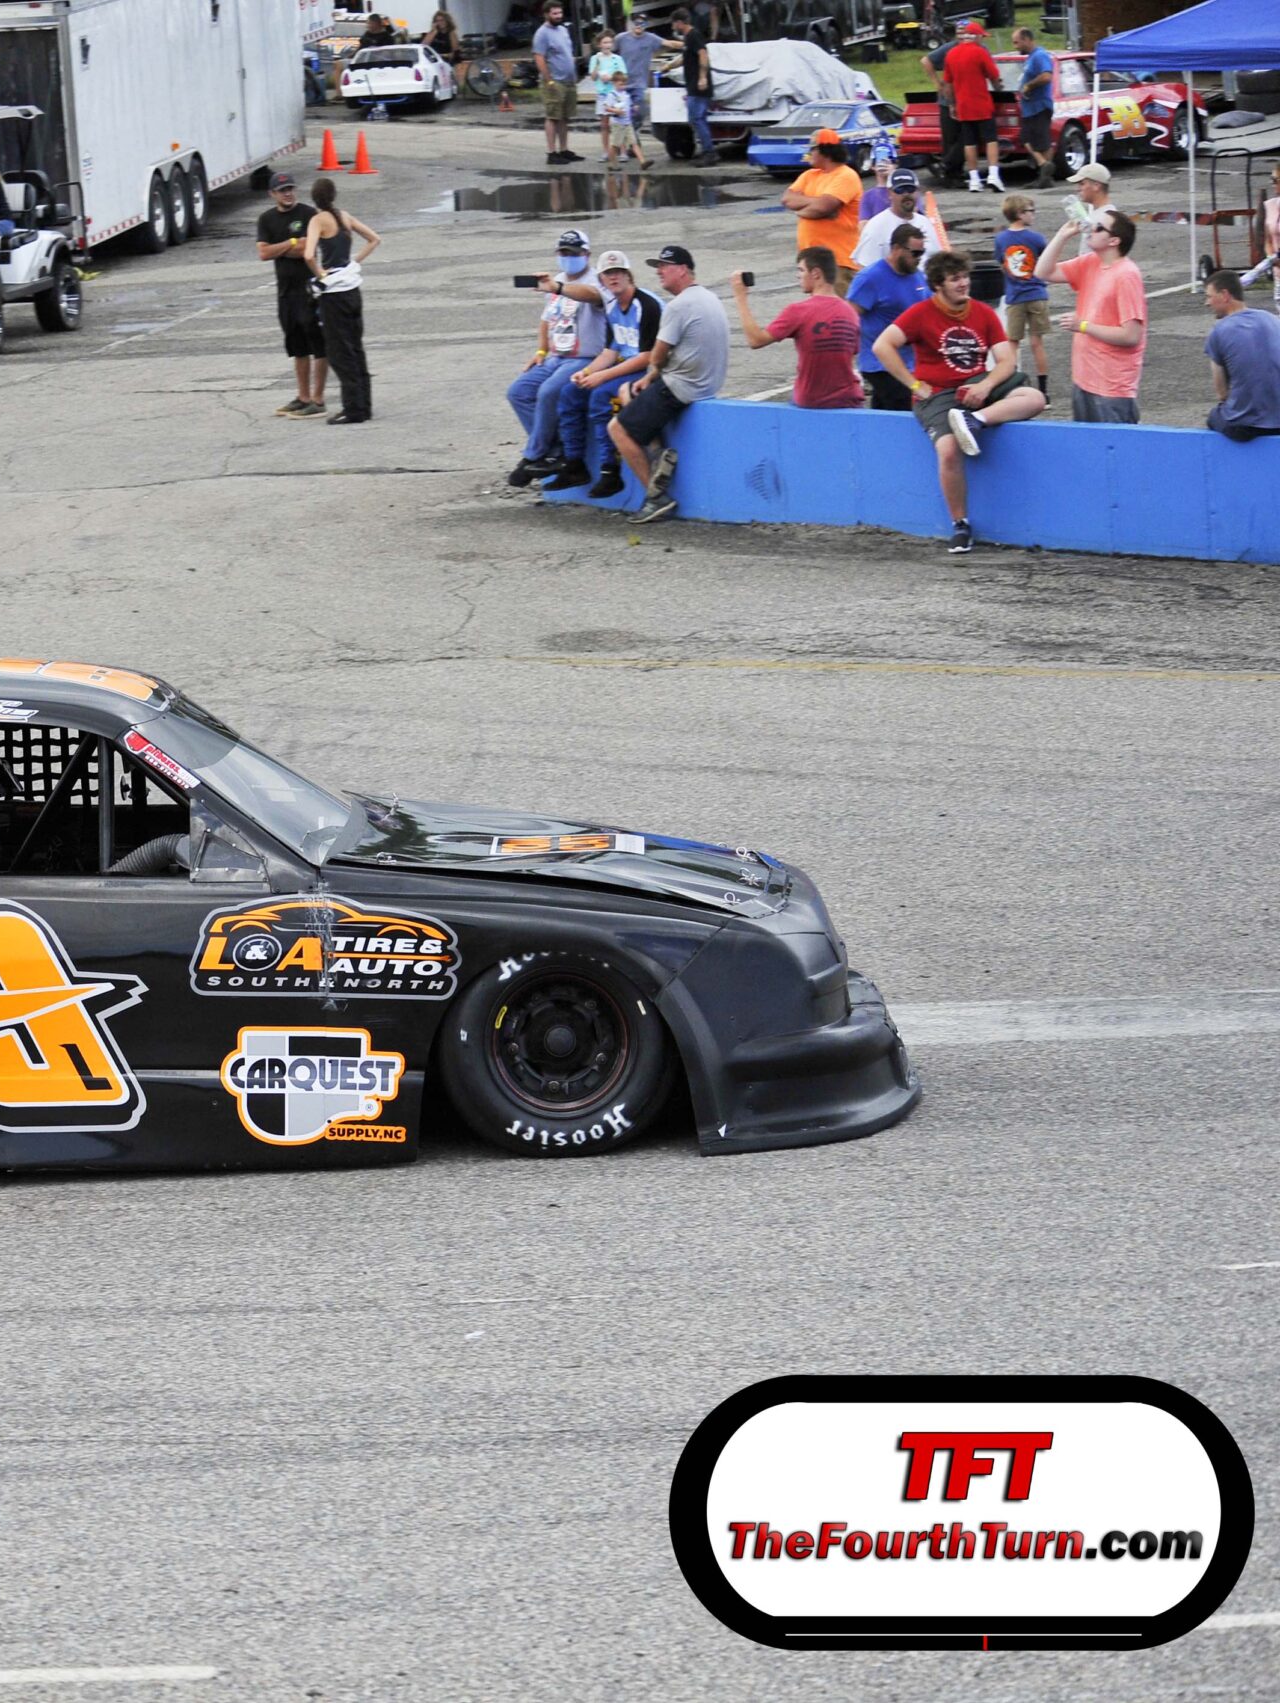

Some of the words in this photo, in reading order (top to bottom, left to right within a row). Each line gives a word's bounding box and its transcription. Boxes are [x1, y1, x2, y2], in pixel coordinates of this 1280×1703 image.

[328, 959, 443, 975] AUTO
[207, 976, 312, 988] SOUTH
[344, 978, 445, 990] NORTH
[230, 1057, 396, 1092] CARQUEST
[328, 1127, 402, 1140] SUPPLY,NC
[505, 1103, 634, 1150] Hoosier
